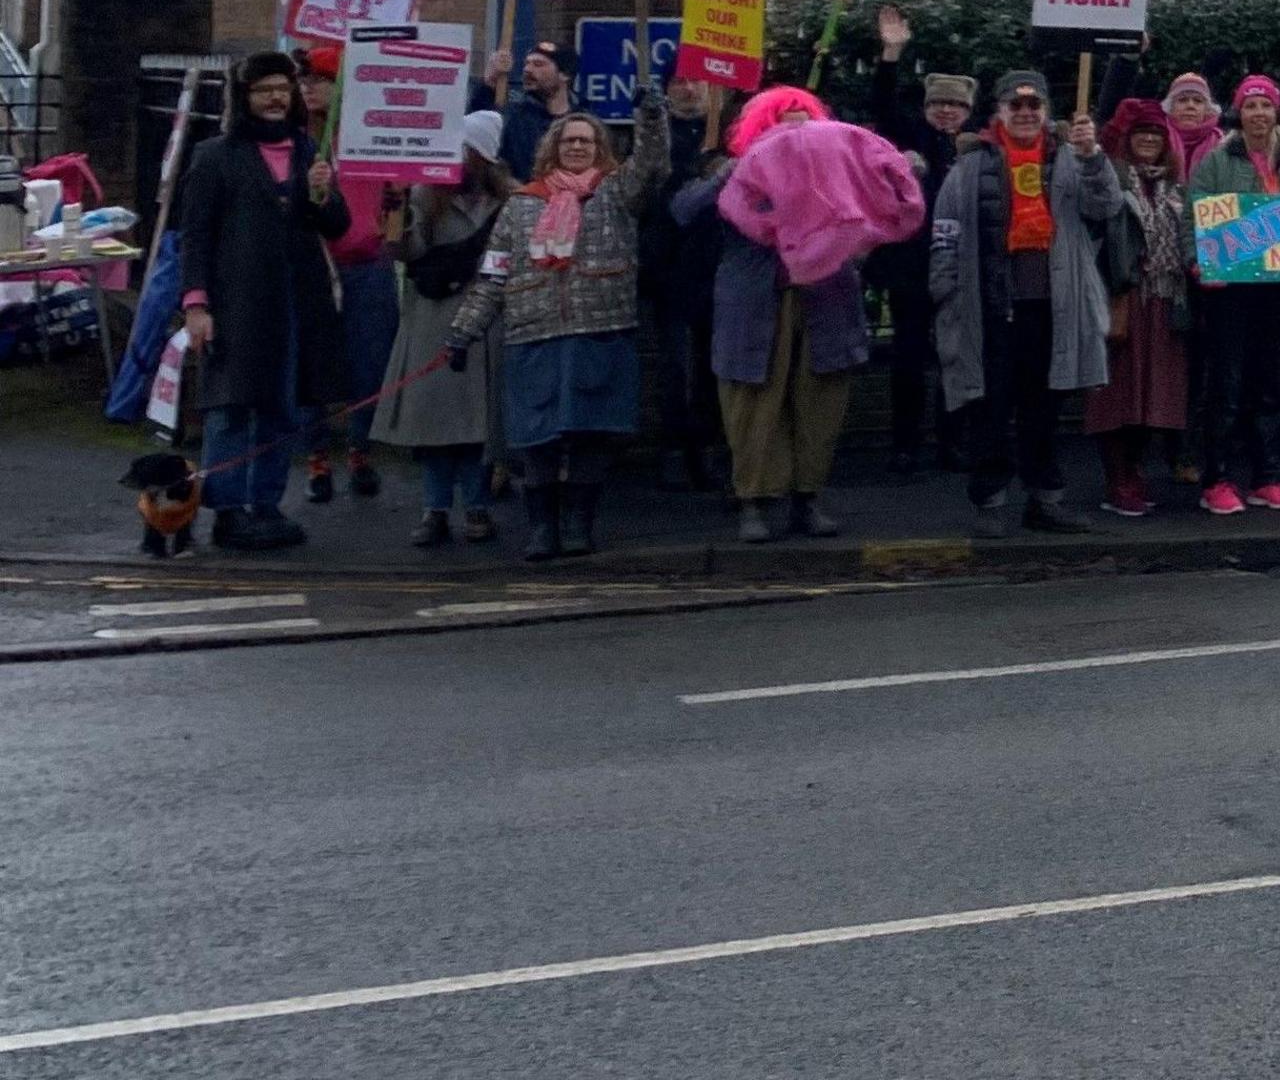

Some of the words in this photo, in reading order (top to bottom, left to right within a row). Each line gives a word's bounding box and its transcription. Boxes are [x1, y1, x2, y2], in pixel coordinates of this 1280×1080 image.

[706, 8, 737, 26] OUR
[694, 28, 747, 50] STRIKE
[1199, 197, 1236, 227] PAY
